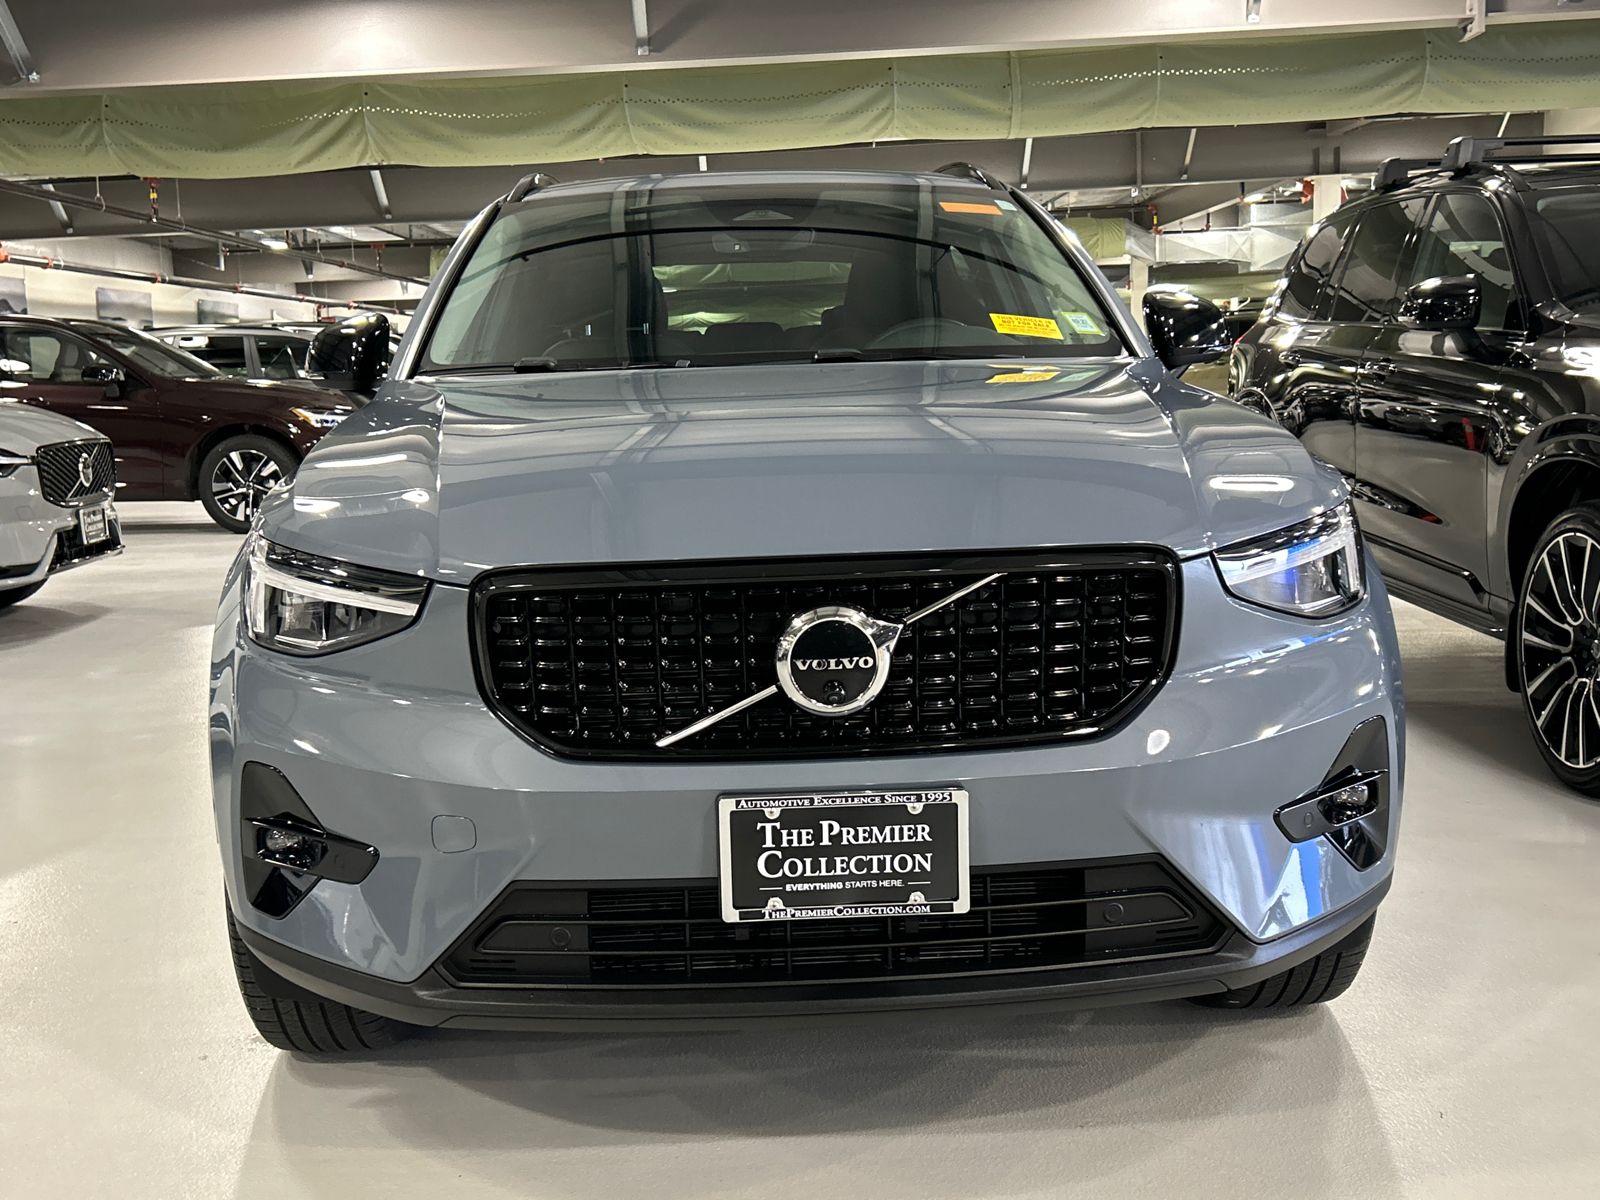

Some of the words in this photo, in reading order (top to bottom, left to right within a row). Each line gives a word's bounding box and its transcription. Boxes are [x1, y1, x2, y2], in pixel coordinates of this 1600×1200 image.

[793, 656, 874, 671] VOLVO
[737, 798, 811, 809] AUTOMOTIVE
[813, 796, 882, 807] EXCELLENCE
[884, 794, 917, 803] SINCE
[921, 792, 951, 802] 1995
[756, 821, 815, 848] THE
[819, 820, 933, 846] PREMIER
[757, 850, 933, 879] COLLECTION
[785, 881, 843, 892] EVERYTHING
[845, 880, 878, 889] STARTS
[879, 879, 905, 887] HERE.
